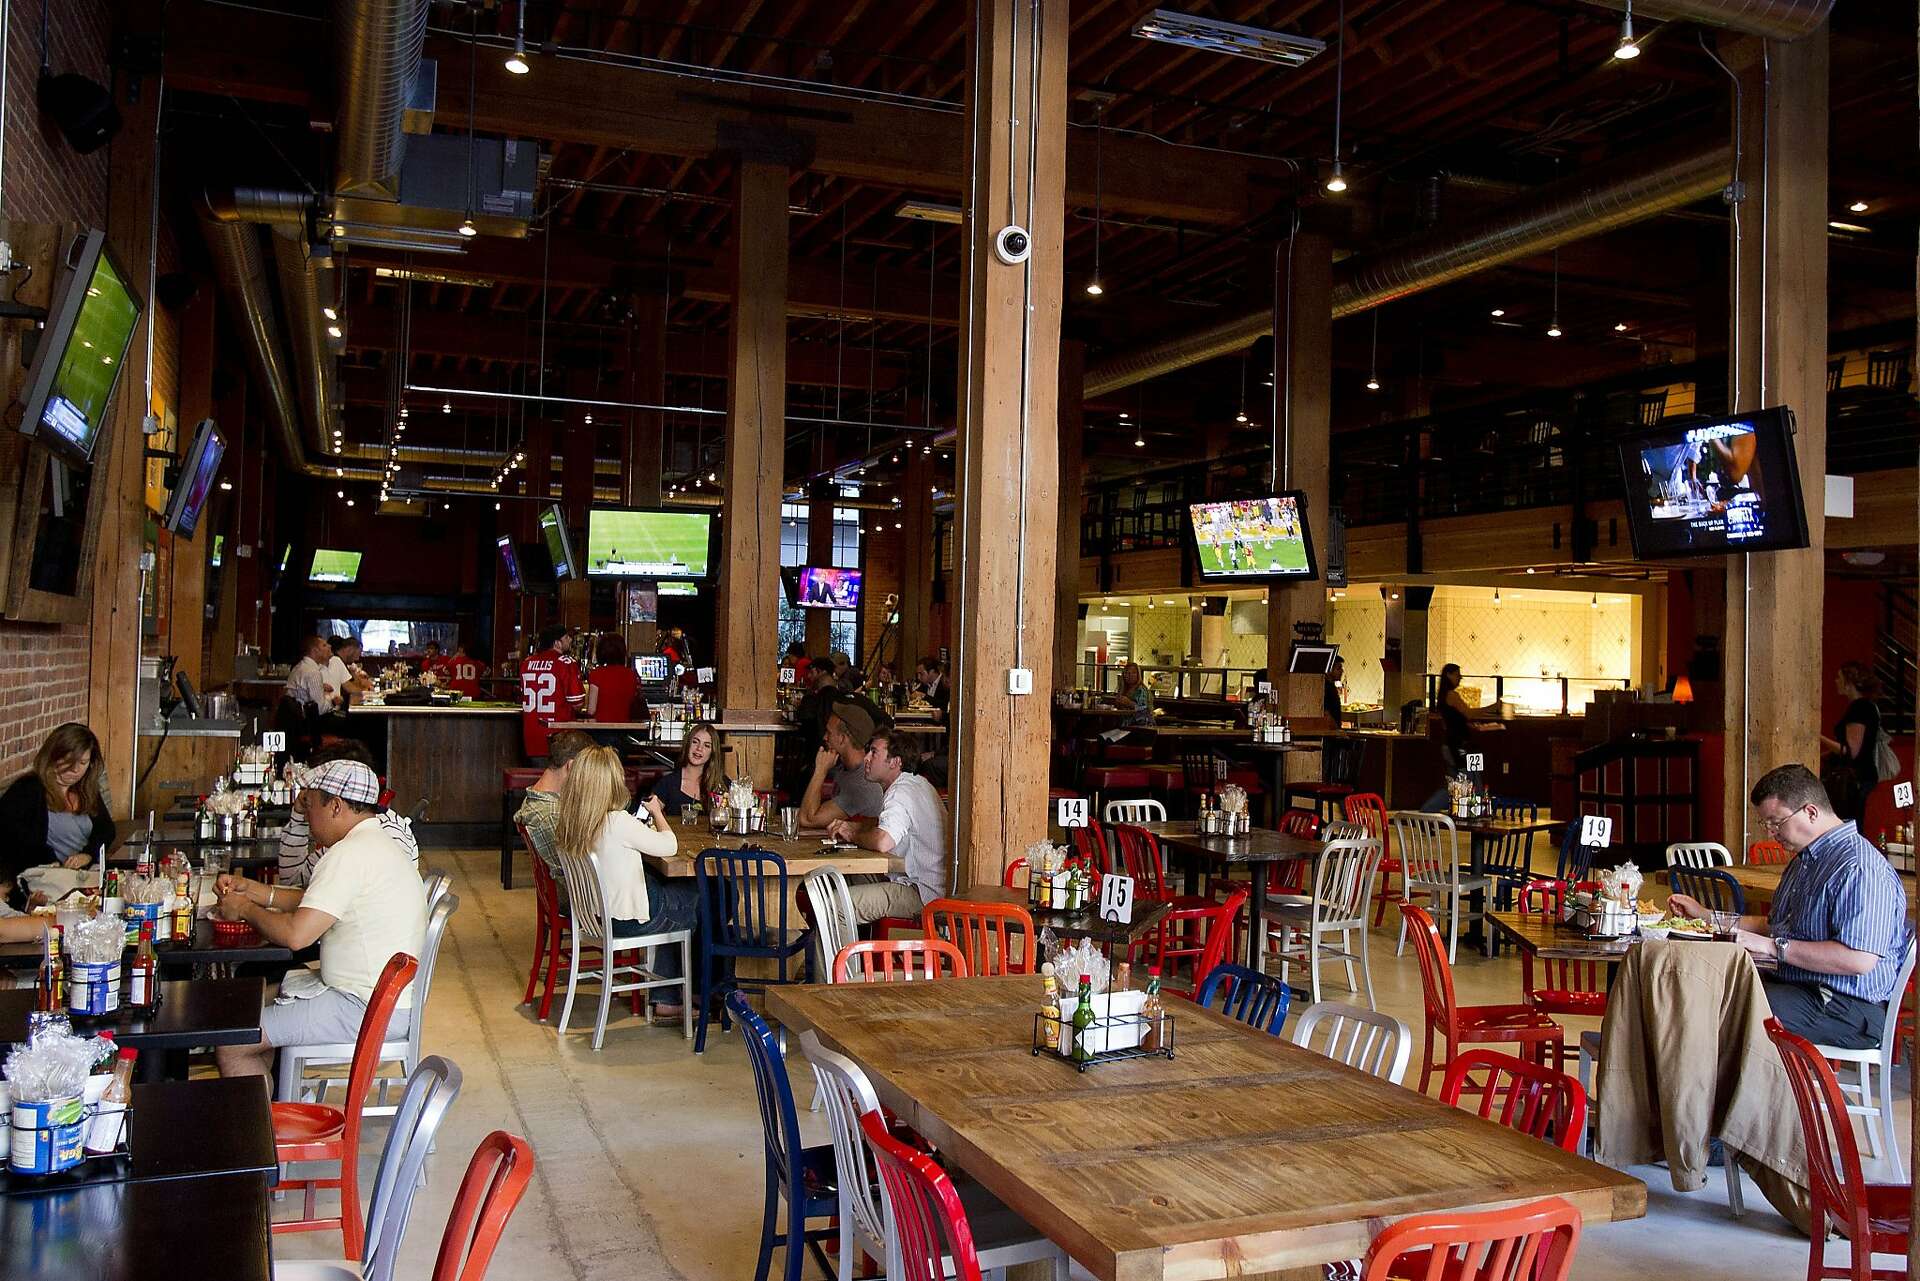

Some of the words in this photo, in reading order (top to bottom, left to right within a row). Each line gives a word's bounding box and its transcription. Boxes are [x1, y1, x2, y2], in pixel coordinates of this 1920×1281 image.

[455, 663, 476, 680] 10
[527, 660, 554, 671] WILLIS
[783, 669, 793, 680] 65
[521, 673, 557, 713] 52
[267, 733, 281, 746] 10
[1469, 755, 1481, 766] 22
[1897, 785, 1910, 801] 23
[1063, 800, 1083, 818] 14
[1588, 818, 1606, 838] 19
[1107, 877, 1128, 908] 15
